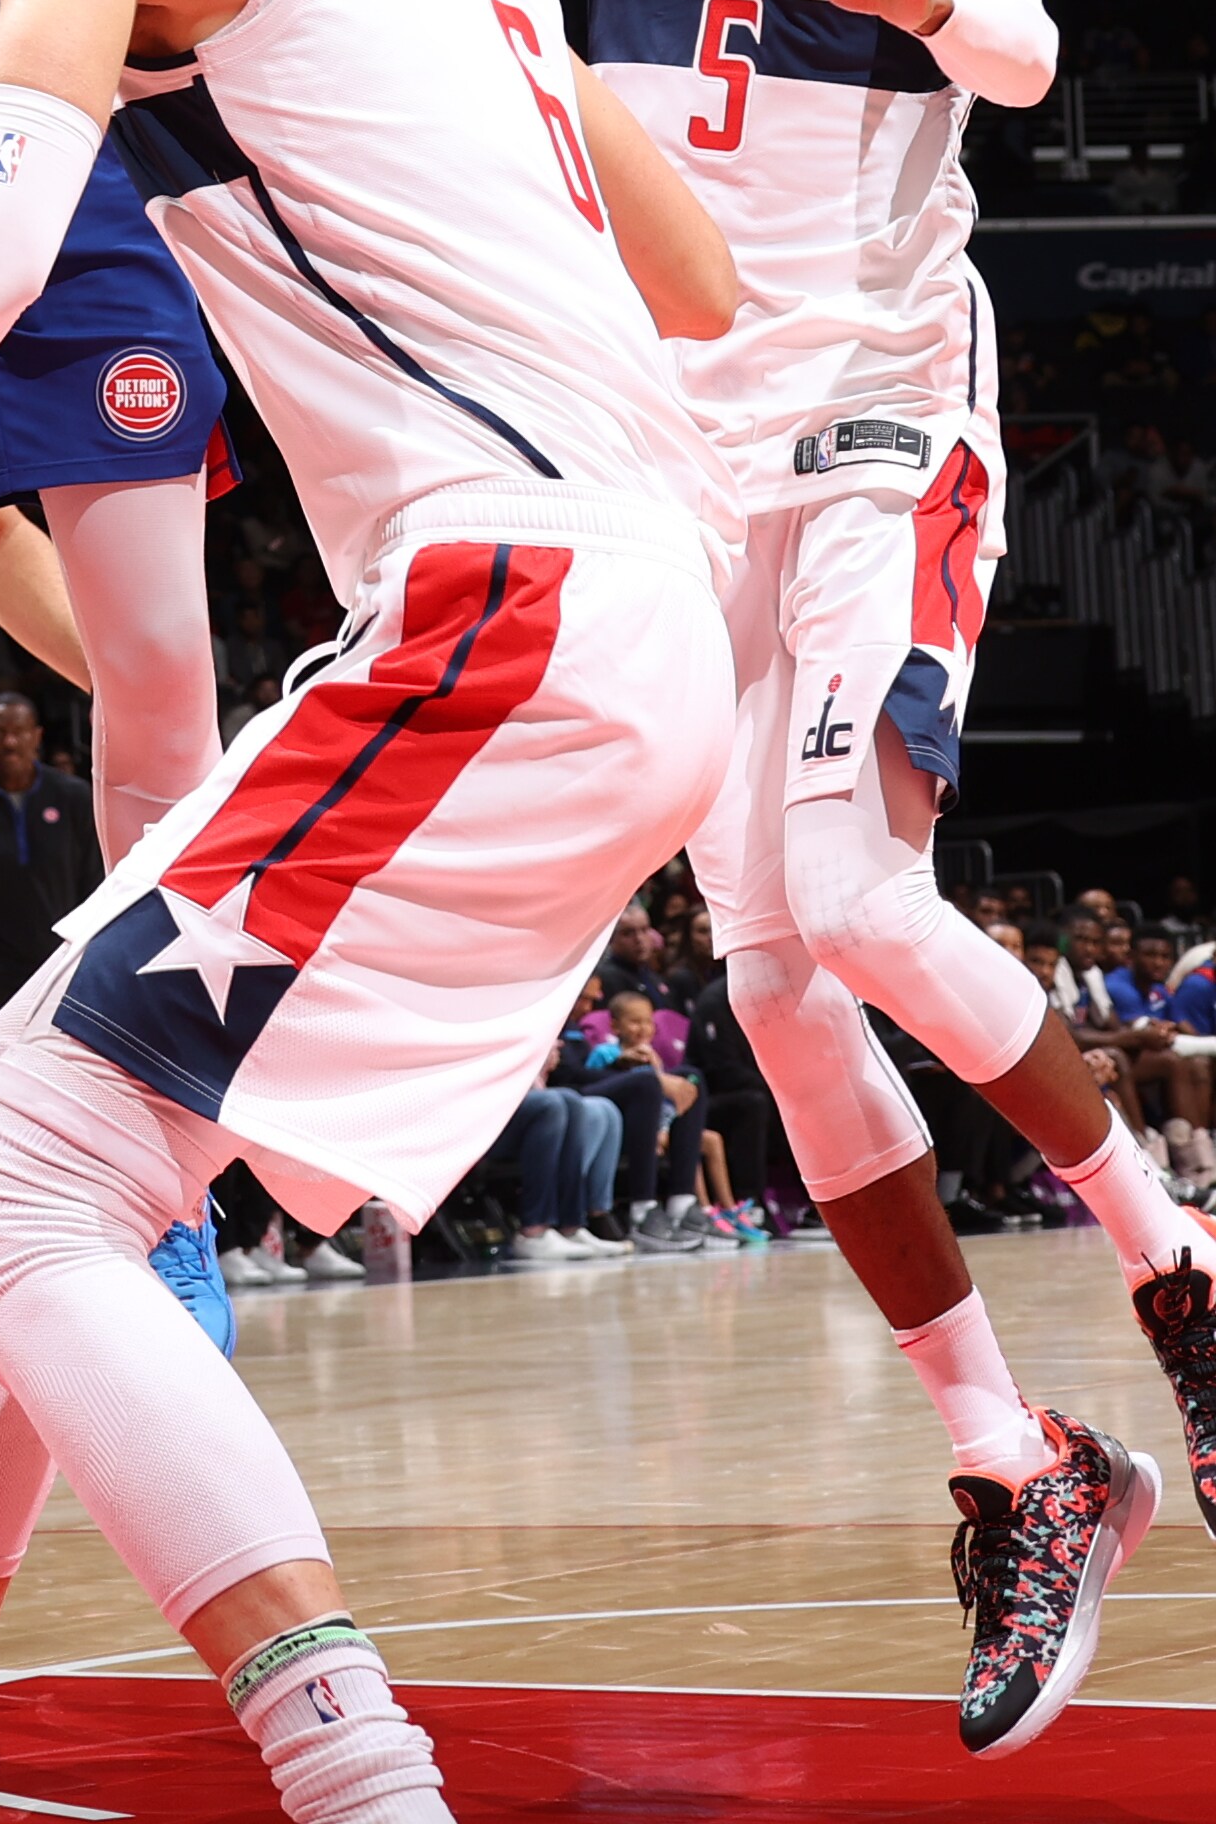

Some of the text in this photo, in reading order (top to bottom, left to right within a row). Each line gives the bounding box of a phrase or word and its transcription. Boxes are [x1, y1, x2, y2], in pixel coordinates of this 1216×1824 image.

[1075, 260, 1216, 296] Capital
[114, 378, 169, 393] DETROIT
[114, 393, 169, 409] PISTONS
[801, 694, 853, 761] dc
